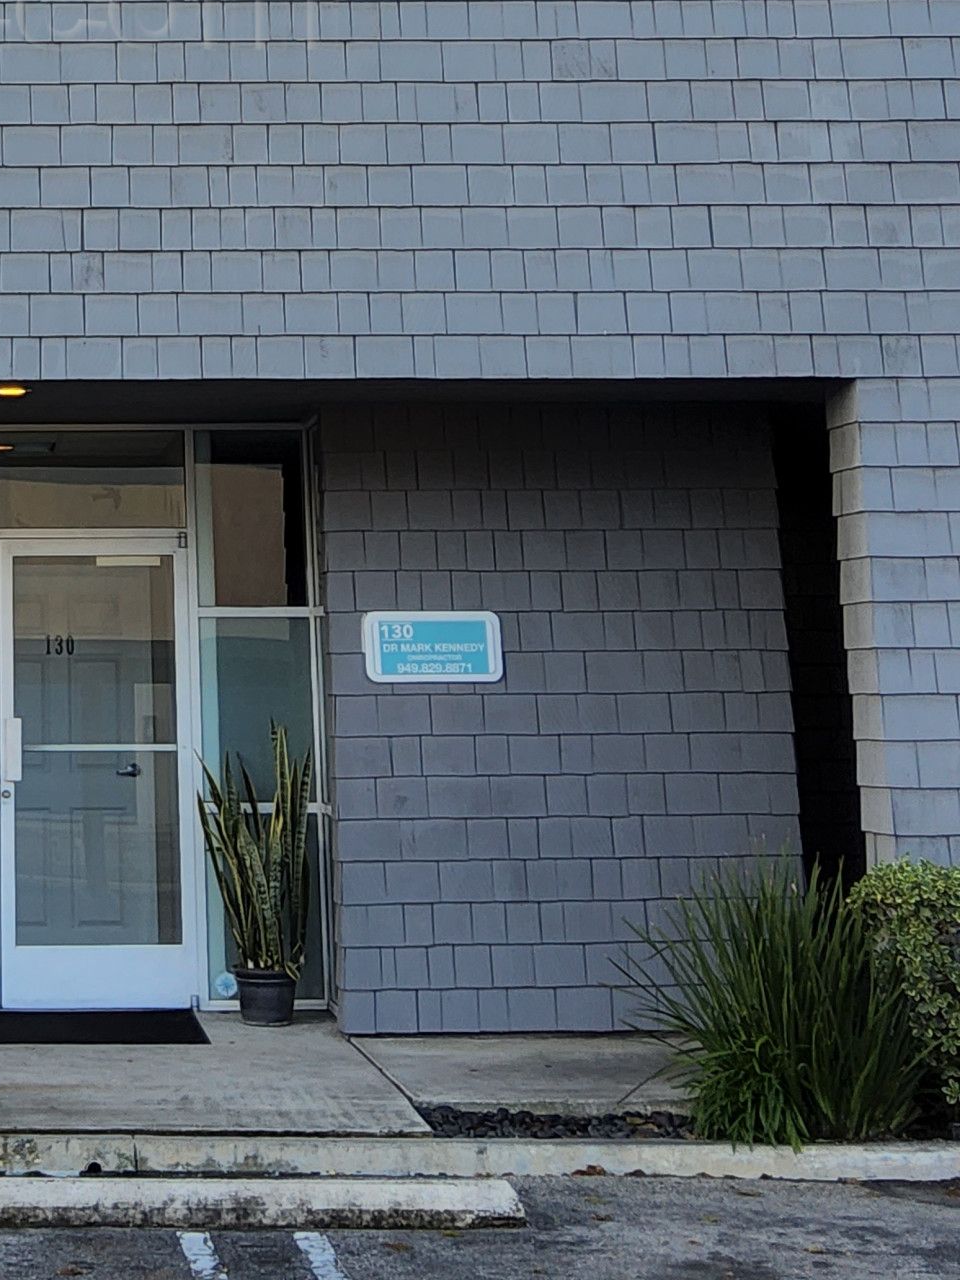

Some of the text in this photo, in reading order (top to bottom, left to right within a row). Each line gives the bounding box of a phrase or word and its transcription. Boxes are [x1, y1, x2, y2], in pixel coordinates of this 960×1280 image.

[380, 624, 414, 638] 130
[46, 634, 75, 655] 130
[382, 642, 485, 653] DR MARK KENNEDY
